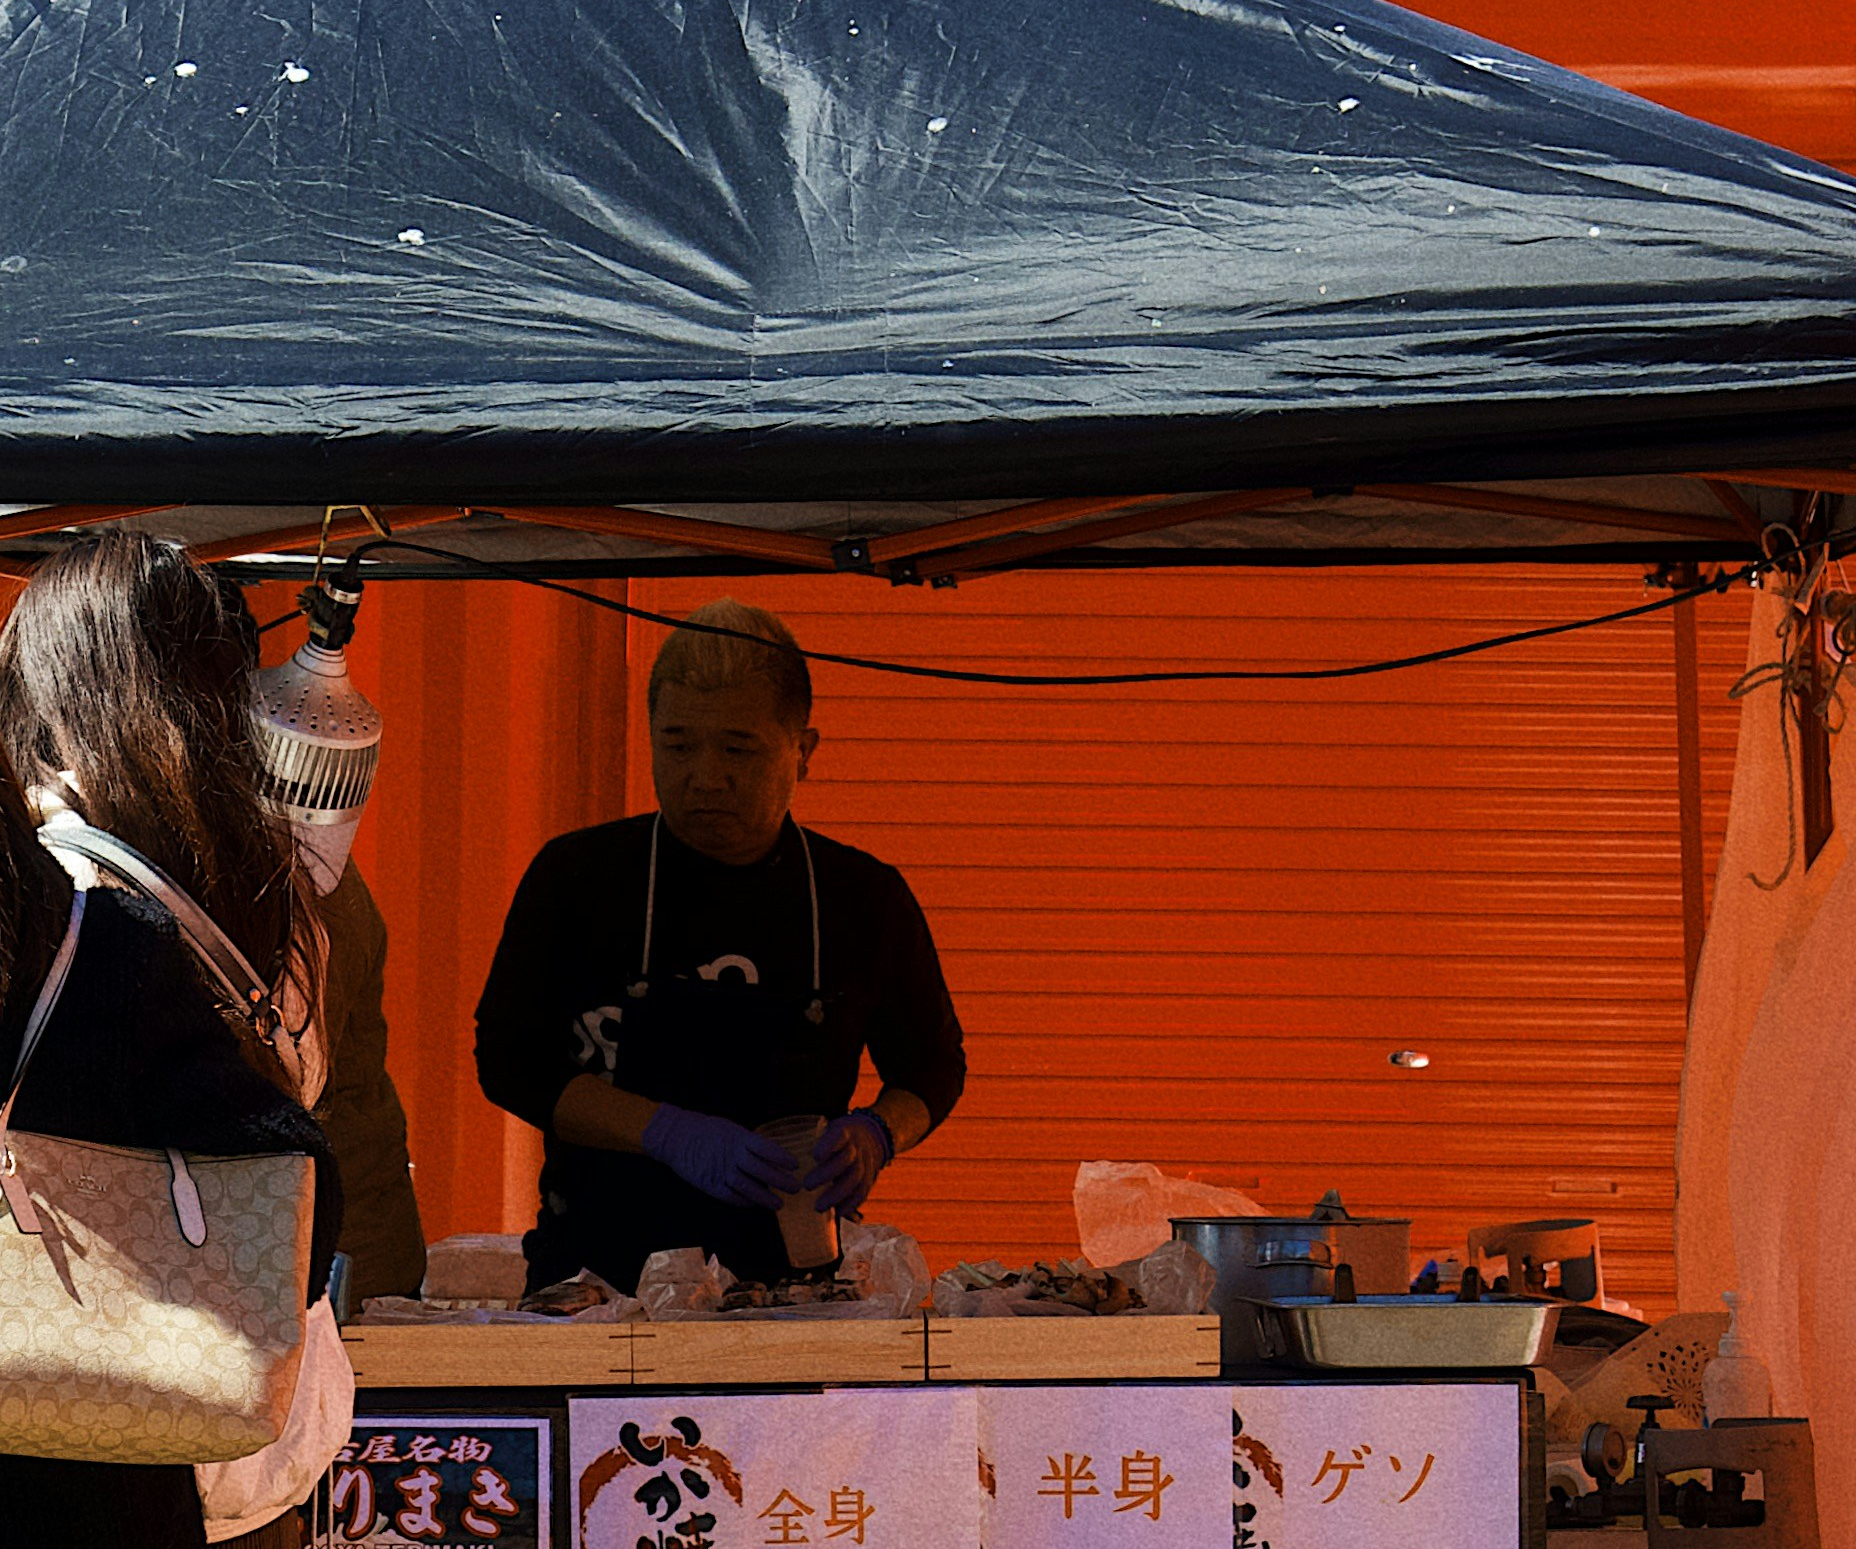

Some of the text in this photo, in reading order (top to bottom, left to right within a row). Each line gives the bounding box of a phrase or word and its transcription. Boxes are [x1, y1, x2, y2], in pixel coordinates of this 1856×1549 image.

[1037, 1450, 1174, 1521] 半身
[1311, 1445, 1436, 1505] ゲソ
[757, 1487, 876, 1546] 全身
